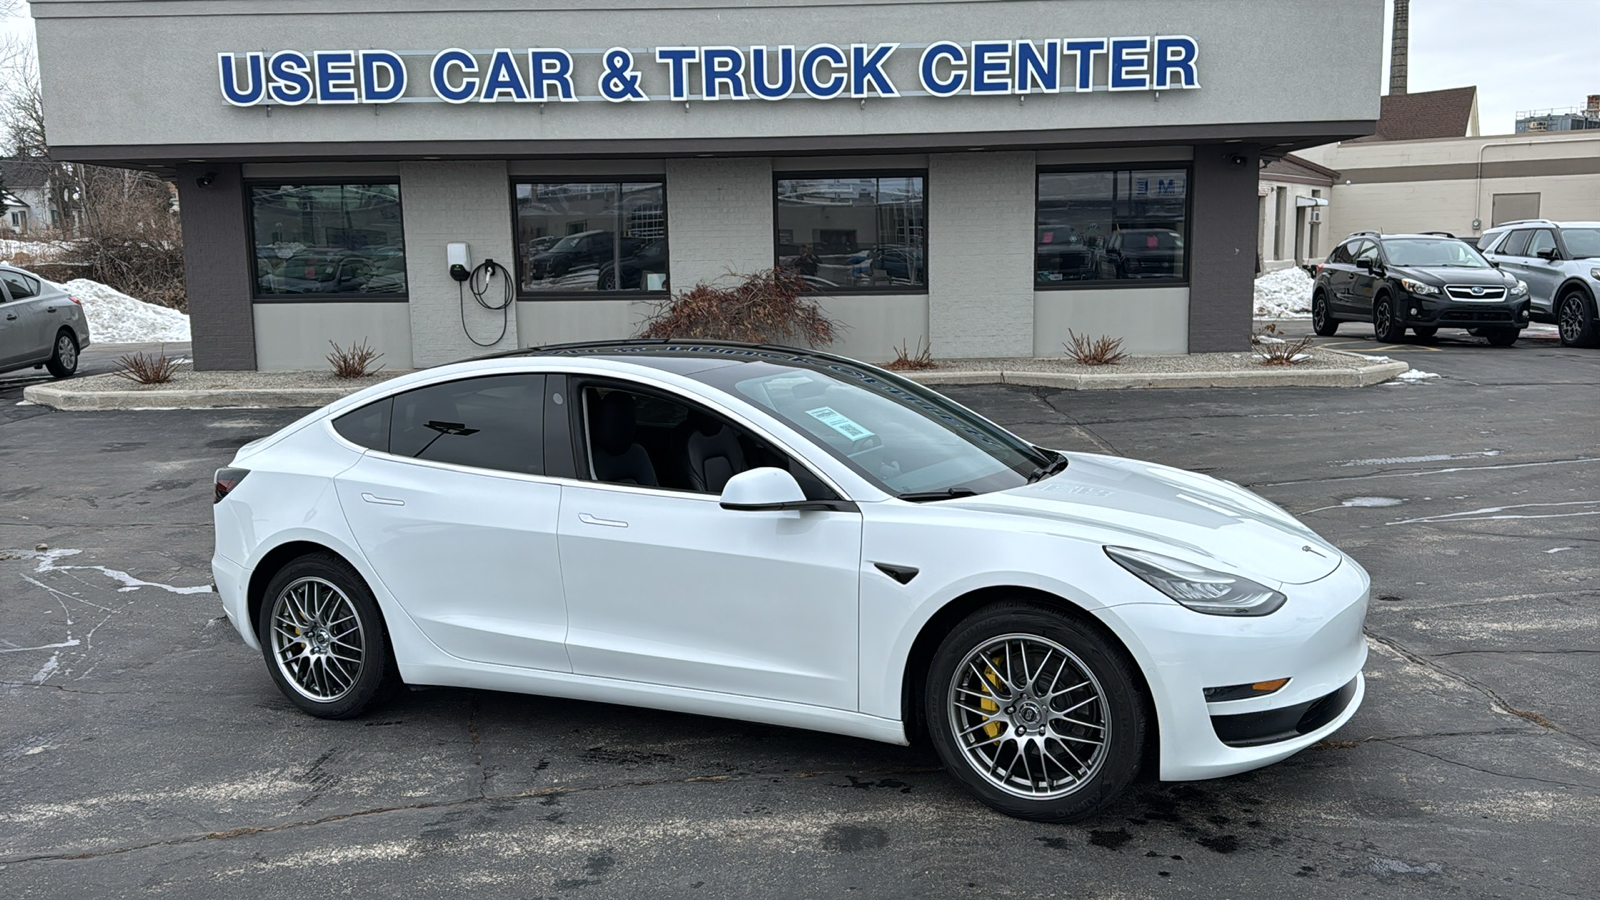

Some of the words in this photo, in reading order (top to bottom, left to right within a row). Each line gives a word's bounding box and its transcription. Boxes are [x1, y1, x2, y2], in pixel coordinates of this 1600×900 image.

[217, 49, 407, 107] USED
[430, 47, 579, 105] CAR
[598, 46, 651, 103] &
[655, 42, 901, 102] TRUCK
[918, 34, 1201, 97] CENTER
